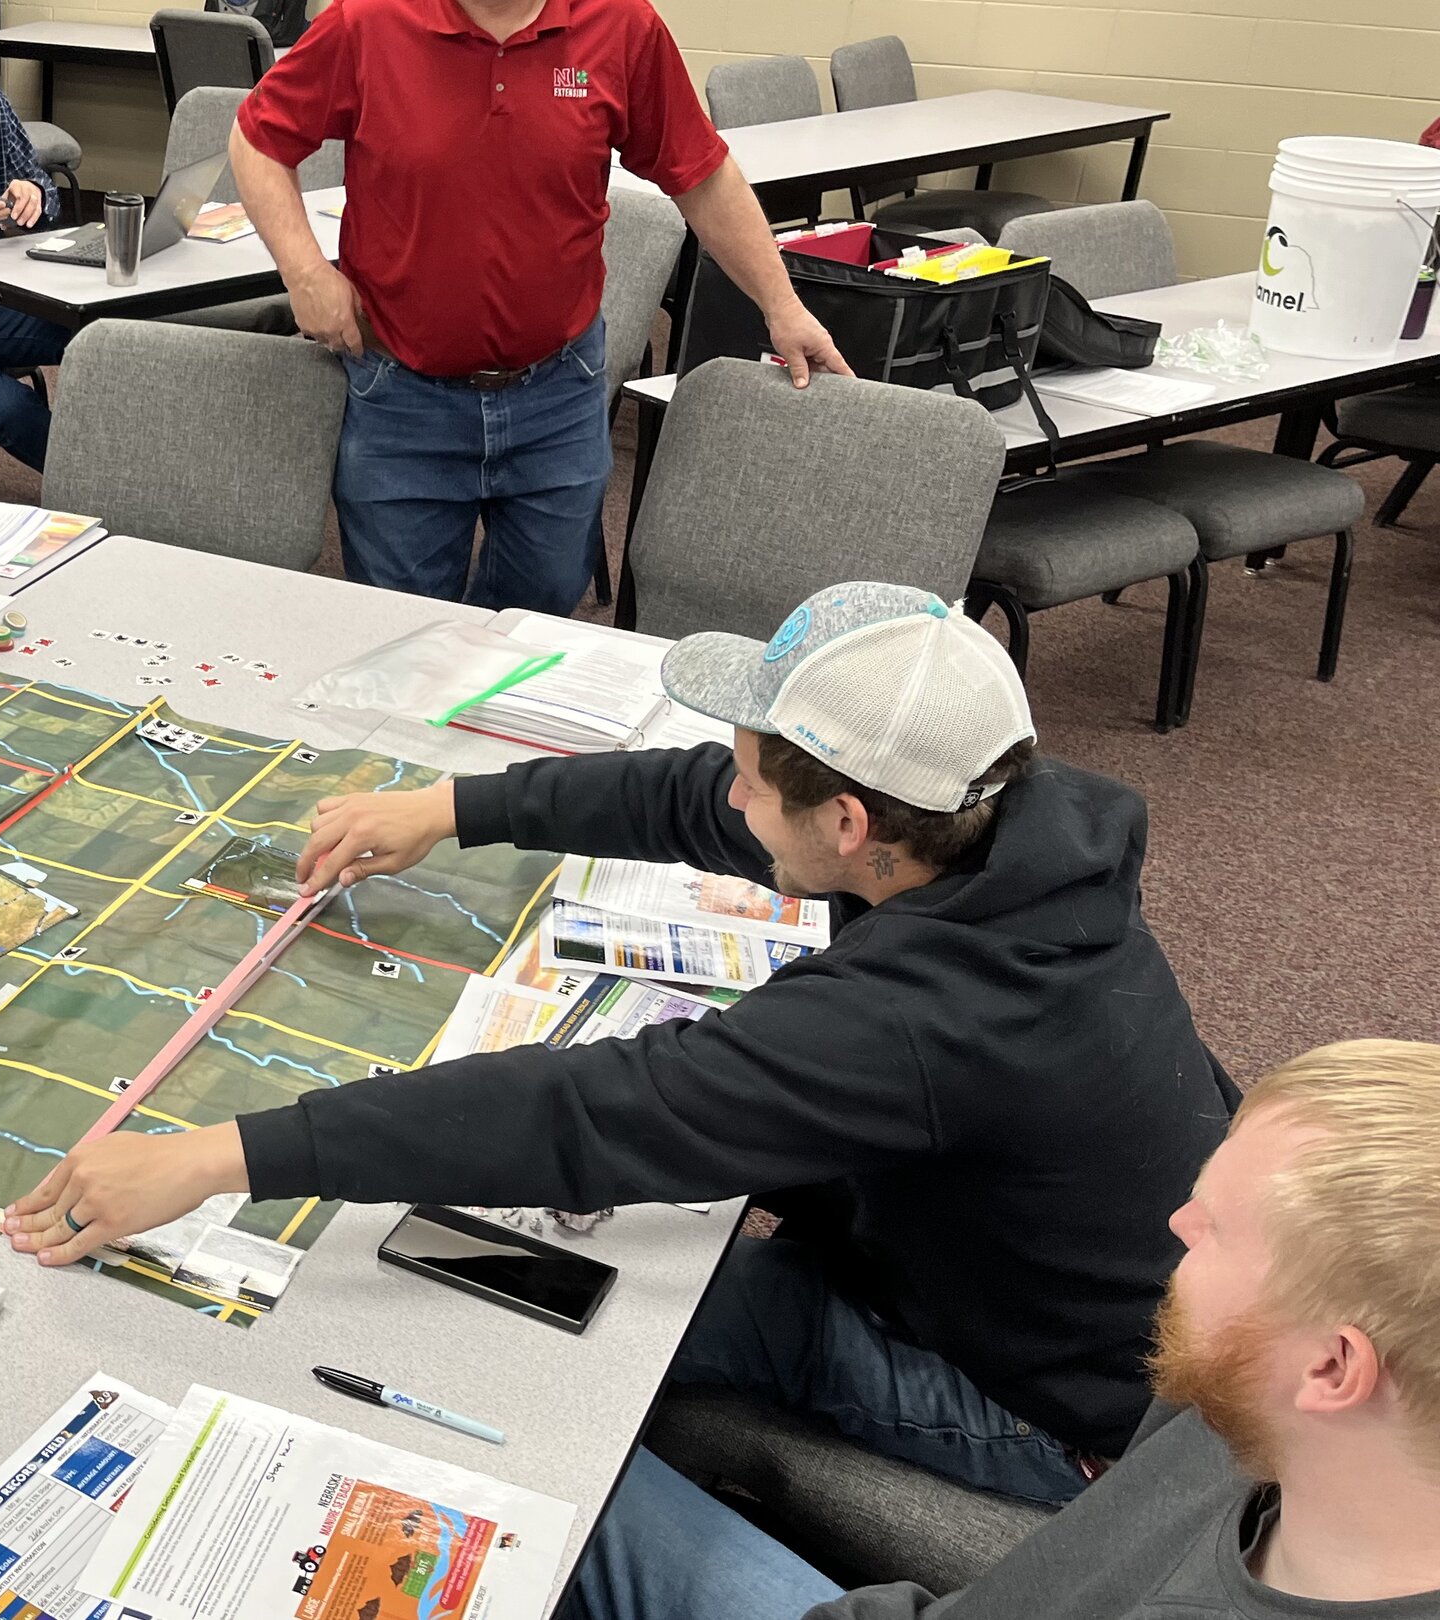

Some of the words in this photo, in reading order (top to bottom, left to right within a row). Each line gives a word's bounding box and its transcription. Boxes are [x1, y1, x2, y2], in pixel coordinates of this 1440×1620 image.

[554, 67, 570, 87] N
[554, 87, 588, 98] EXTENSION
[796, 724, 839, 757] ARIAT
[1, 1463, 37, 1496] RECORD
[43, 1436, 66, 1458] FIELD
[61, 1430, 72, 1439] 2
[63, 1469, 78, 1482] TYPE:
[77, 1470, 97, 1490] AVERAGE
[96, 1449, 118, 1471] AMOUNT:
[265, 1462, 285, 1483] Stop
[280, 1437, 294, 1458] here
[91, 1482, 107, 1497] WATER
[105, 1463, 125, 1483] NITRATE:
[111, 1482, 127, 1498] WATER
[126, 1465, 144, 1484] QUALITY
[144, 1507, 165, 1540] Considering
[161, 1485, 179, 1513] Setbacks
[182, 1445, 201, 1477] Stockpiling
[317, 1473, 343, 1508] NEBRASKA
[31, 1498, 51, 1518] Soybean
[319, 1506, 338, 1536] MANURE
[332, 1476, 355, 1510] SETBACKS
[0, 1555, 17, 1571] GOAL:
[13, 1541, 48, 1574] INFORMATION
[13, 1571, 35, 1592] Annually
[33, 1566, 56, 1588] Anhydrous
[302, 1597, 320, 1619] LARGE
